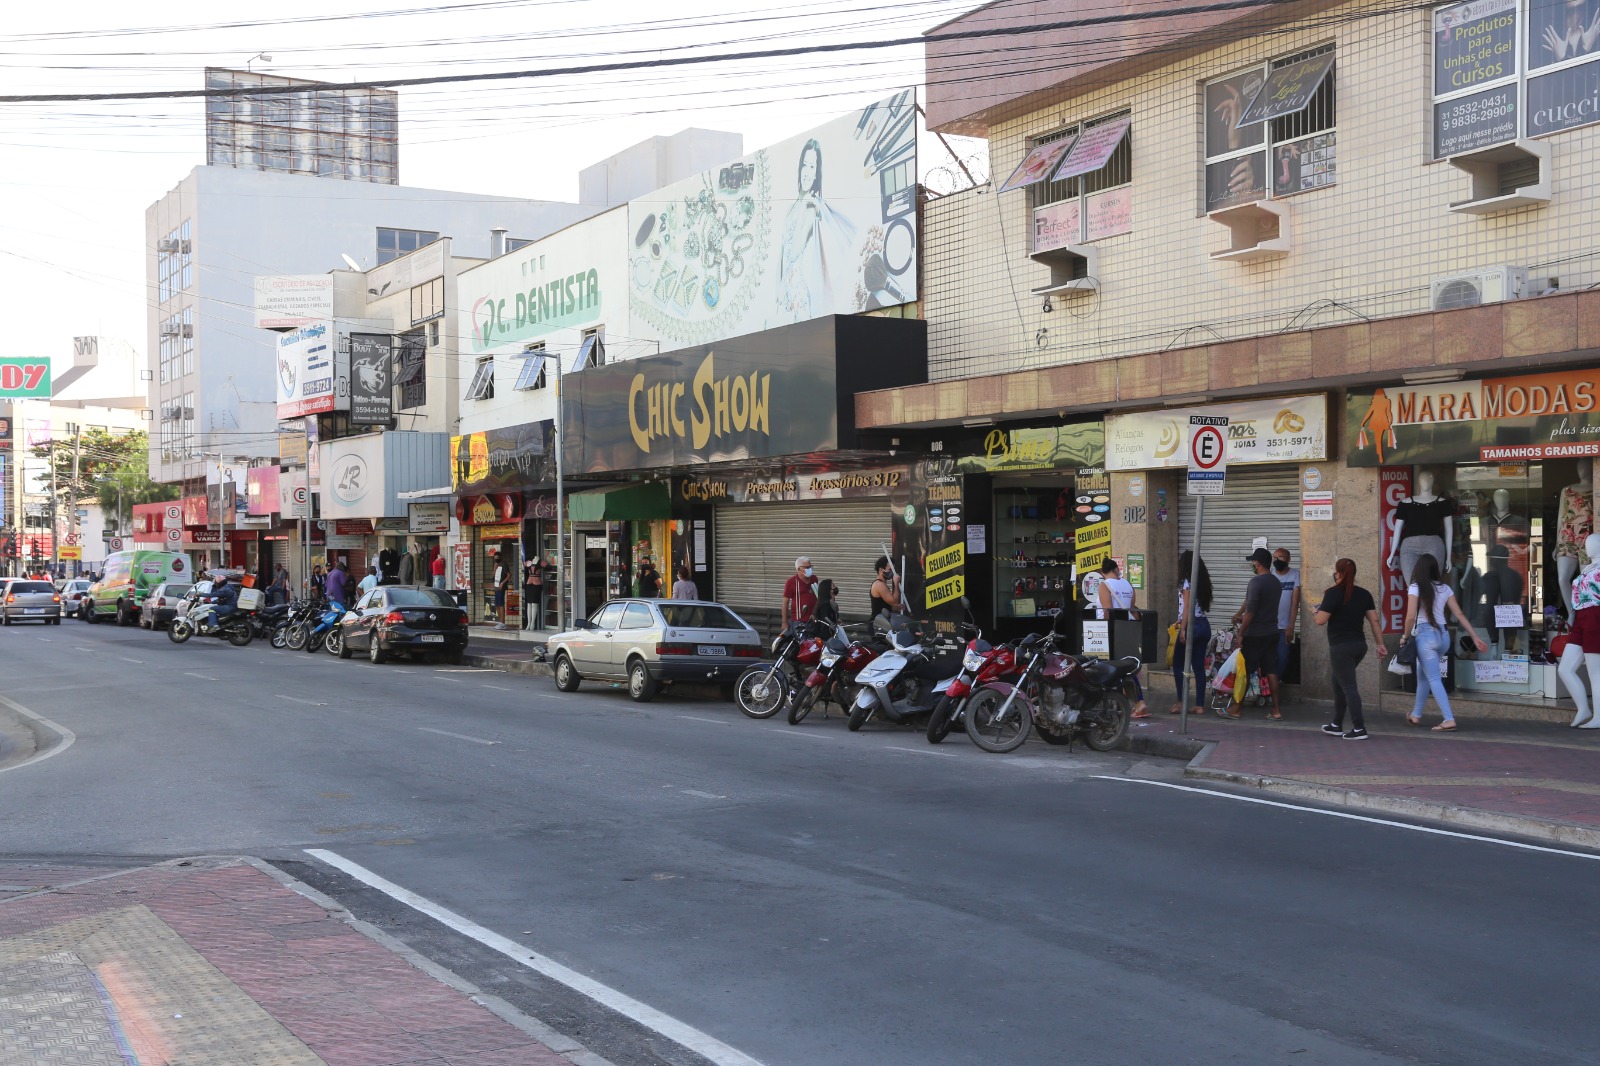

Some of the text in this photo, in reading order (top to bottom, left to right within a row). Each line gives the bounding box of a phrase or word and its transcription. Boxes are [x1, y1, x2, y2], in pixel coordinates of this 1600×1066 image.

[1455, 14, 1513, 41] Produtos
[1468, 34, 1492, 52] para
[1443, 39, 1512, 70] Unhas de Gel
[1451, 62, 1503, 87] Cursos
[1441, 93, 1507, 120] 31 3532-0431
[1442, 105, 1507, 131] 9 9838-2990
[1564, 117, 1583, 126] BRASIL
[1441, 137, 1457, 147] Logo
[1458, 131, 1472, 143] aqui
[1472, 129, 1491, 139] nesse
[1100, 198, 1121, 209] CURSOS
[1035, 216, 1072, 236] Perfect
[515, 267, 599, 330] DENTISTA
[628, 350, 771, 454] CHIC SHOW
[1397, 381, 1597, 425] MARA MODAS
[1191, 416, 1227, 426] ROTATIVO
[1550, 418, 1576, 440] plus
[931, 440, 943, 451] 806
[1115, 443, 1144, 454] Relógios
[1201, 436, 1214, 459] E
[1233, 439, 1257, 449] JOIAS
[1266, 436, 1313, 448] 3531-5971
[1482, 444, 1599, 459] TAMANHOS GRANDES
[1077, 475, 1109, 490] TÉCNICA
[1382, 471, 1409, 481] MODA
[681, 471, 901, 501] CHIC SHOW Presentes Acessórios 812
[928, 484, 961, 501] TÉCNICA
[1123, 506, 1146, 524] 802
[1077, 526, 1109, 544] CELULARES
[928, 549, 962, 573] CELULARES
